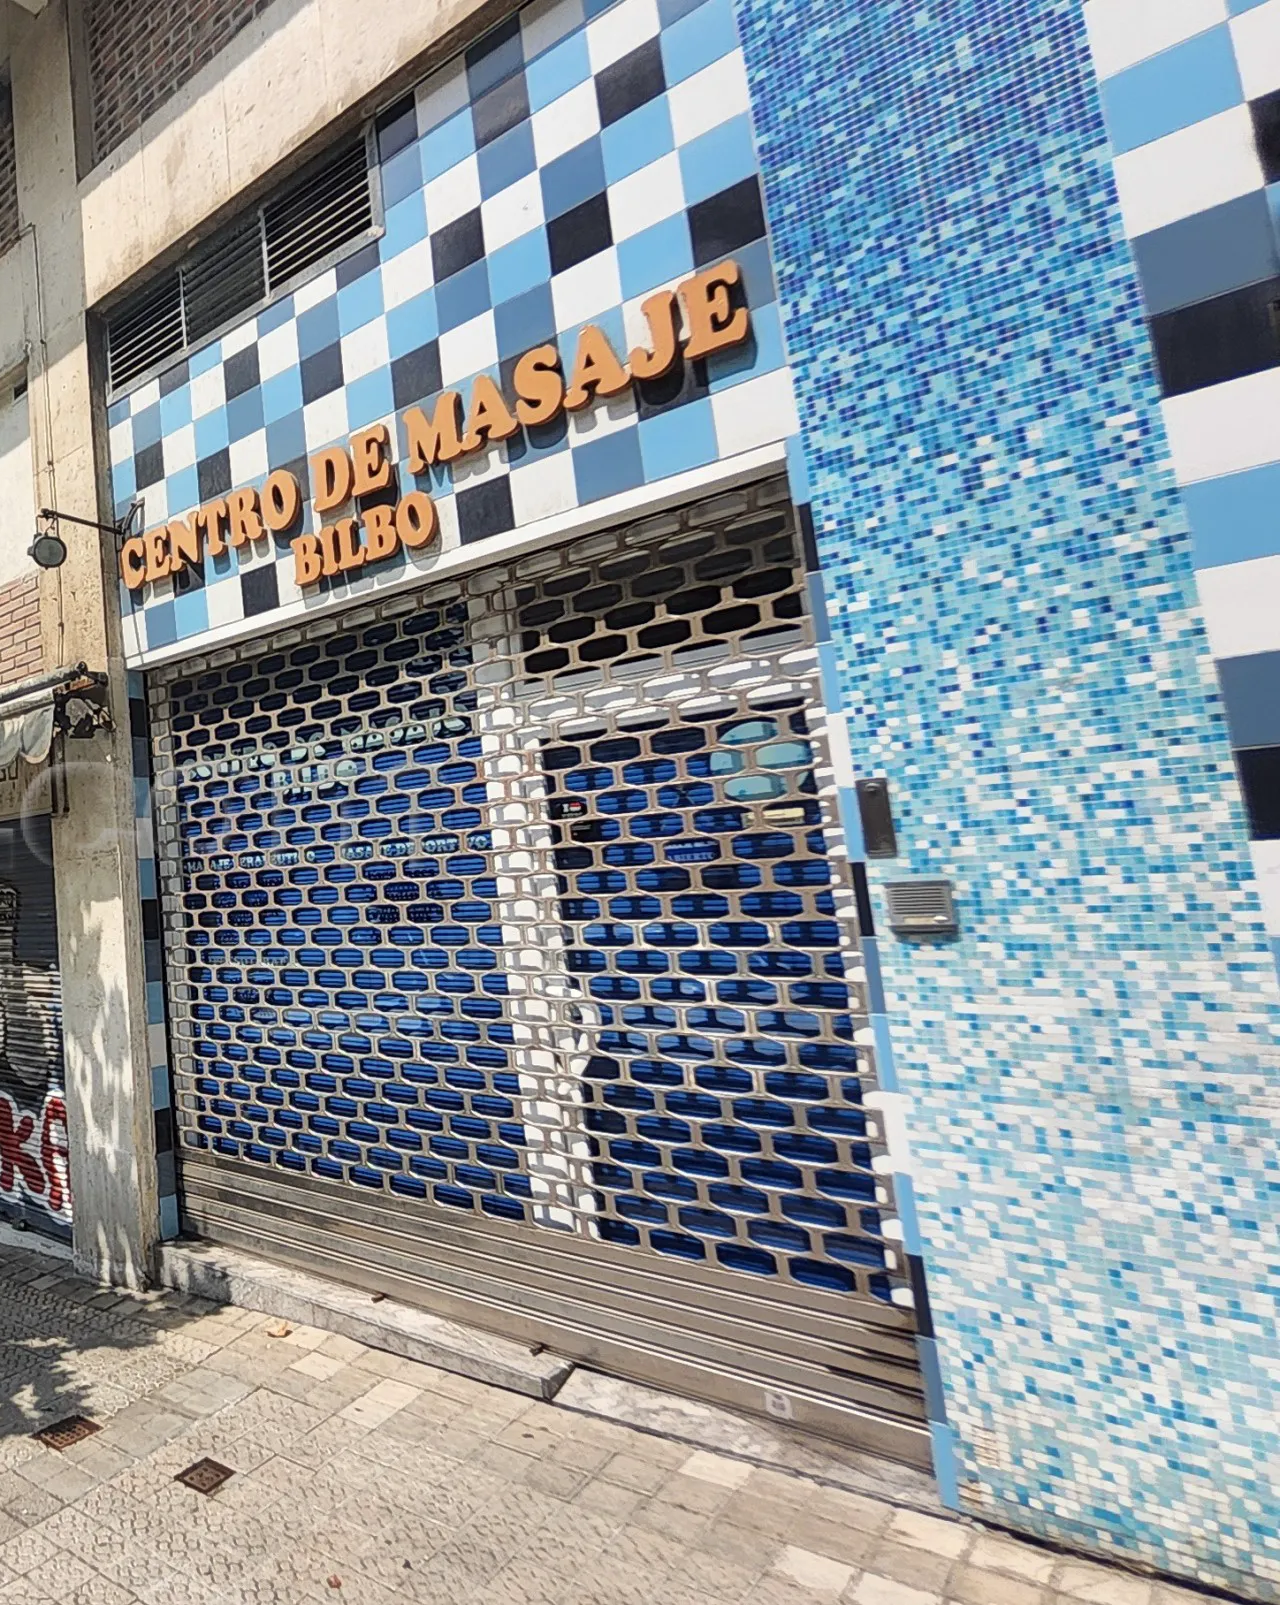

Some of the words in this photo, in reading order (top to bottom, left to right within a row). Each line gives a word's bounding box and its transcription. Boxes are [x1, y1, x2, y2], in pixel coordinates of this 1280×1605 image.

[120, 472, 300, 589] CENTRO
[312, 426, 392, 513] DE
[404, 260, 749, 475] MASAJE
[293, 492, 437, 587] BILBO
